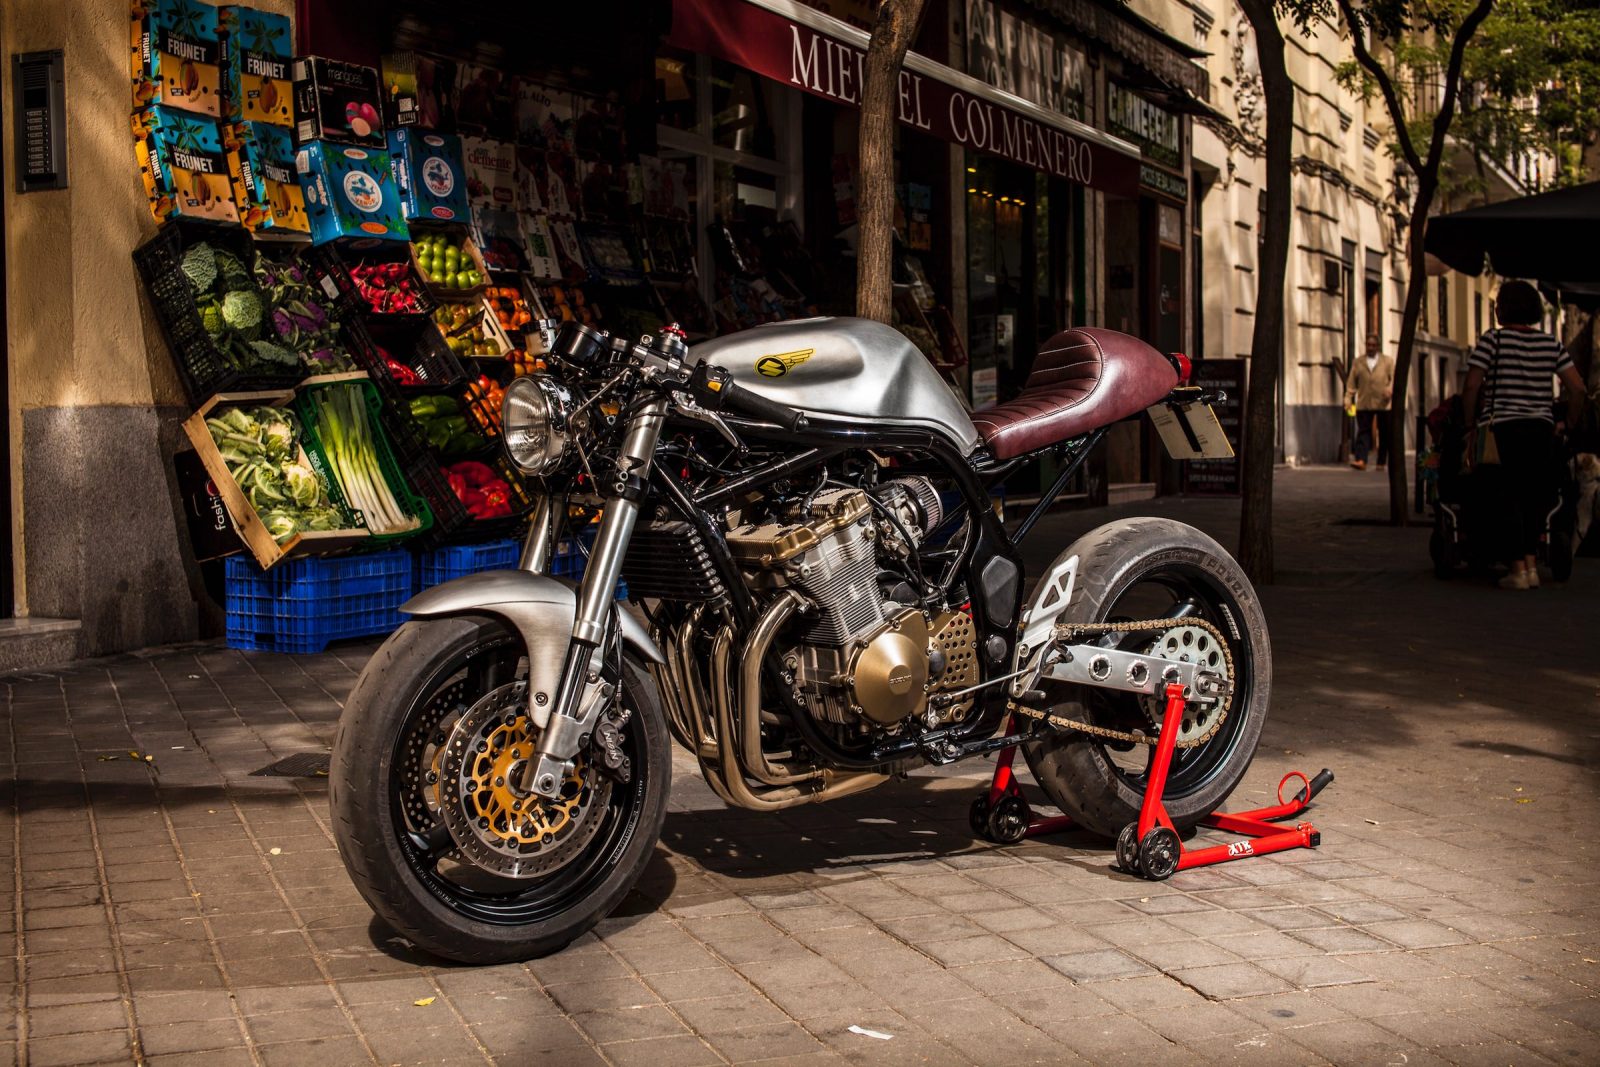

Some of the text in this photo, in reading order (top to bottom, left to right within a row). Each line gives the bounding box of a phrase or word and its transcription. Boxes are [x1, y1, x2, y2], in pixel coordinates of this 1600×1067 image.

[142, 32, 151, 63] FRUNET
[167, 38, 207, 62] FRUNET
[969, 2, 1083, 94] ACUPUNTURA
[247, 58, 285, 79] FRUNET
[327, 68, 363, 84] mangoes
[949, 92, 1093, 185] COLMENERO
[150, 149, 162, 180] FRUNET
[174, 152, 213, 173] FRUNET
[241, 161, 255, 191] FRUNET
[265, 164, 291, 183] FRUNET
